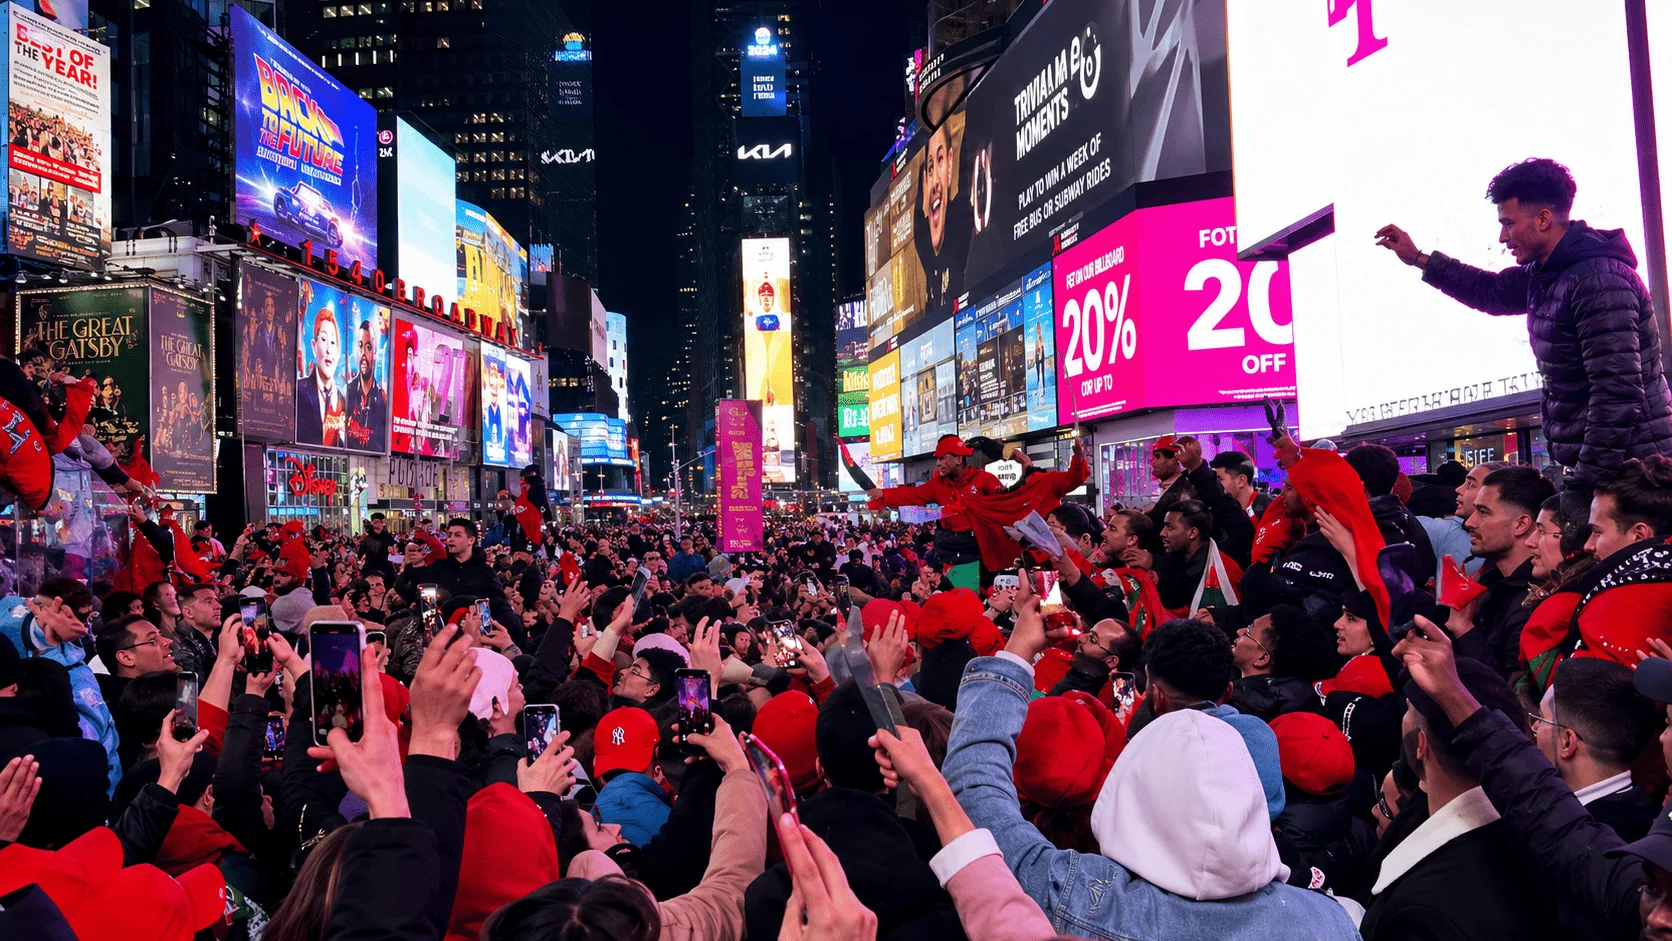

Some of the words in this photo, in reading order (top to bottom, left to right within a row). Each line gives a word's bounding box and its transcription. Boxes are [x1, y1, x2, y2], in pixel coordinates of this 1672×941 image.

[16, 22, 63, 58] BST
[69, 49, 94, 70] OF
[1327, 0, 1388, 67] T
[15, 42, 39, 61] THE
[41, 52, 97, 90] YEAR!
[253, 52, 344, 148] BACK
[261, 109, 278, 131] TO
[1016, 87, 1069, 161] MOMENTS
[259, 128, 277, 148] THE
[277, 117, 345, 176] FUTURE
[737, 143, 792, 160] KIA
[1018, 184, 1034, 211] PLAY
[1035, 177, 1044, 198] TO
[1045, 165, 1059, 190] WIN
[1060, 161, 1066, 180] A
[1066, 142, 1089, 174] WEEK
[1090, 132, 1101, 156] OF
[1013, 217, 1029, 241] FREE
[1029, 207, 1042, 229] BUS
[1043, 199, 1054, 219] OR
[1054, 175, 1085, 212] SUBWAY
[1086, 158, 1111, 190] RIDES
[1094, 245, 1124, 275] BILLBOARD
[301, 239, 385, 295] 1540
[392, 277, 516, 348] BROADWAY
[36, 320, 69, 340] THE
[72, 315, 133, 338] GREAT
[49, 336, 124, 360] GATSBY
[1062, 273, 1136, 378] 20%
[1094, 376, 1103, 394] UP
[1103, 373, 1113, 391] TO
[1242, 353, 1286, 374] OFF
[285, 457, 336, 507] Disney
